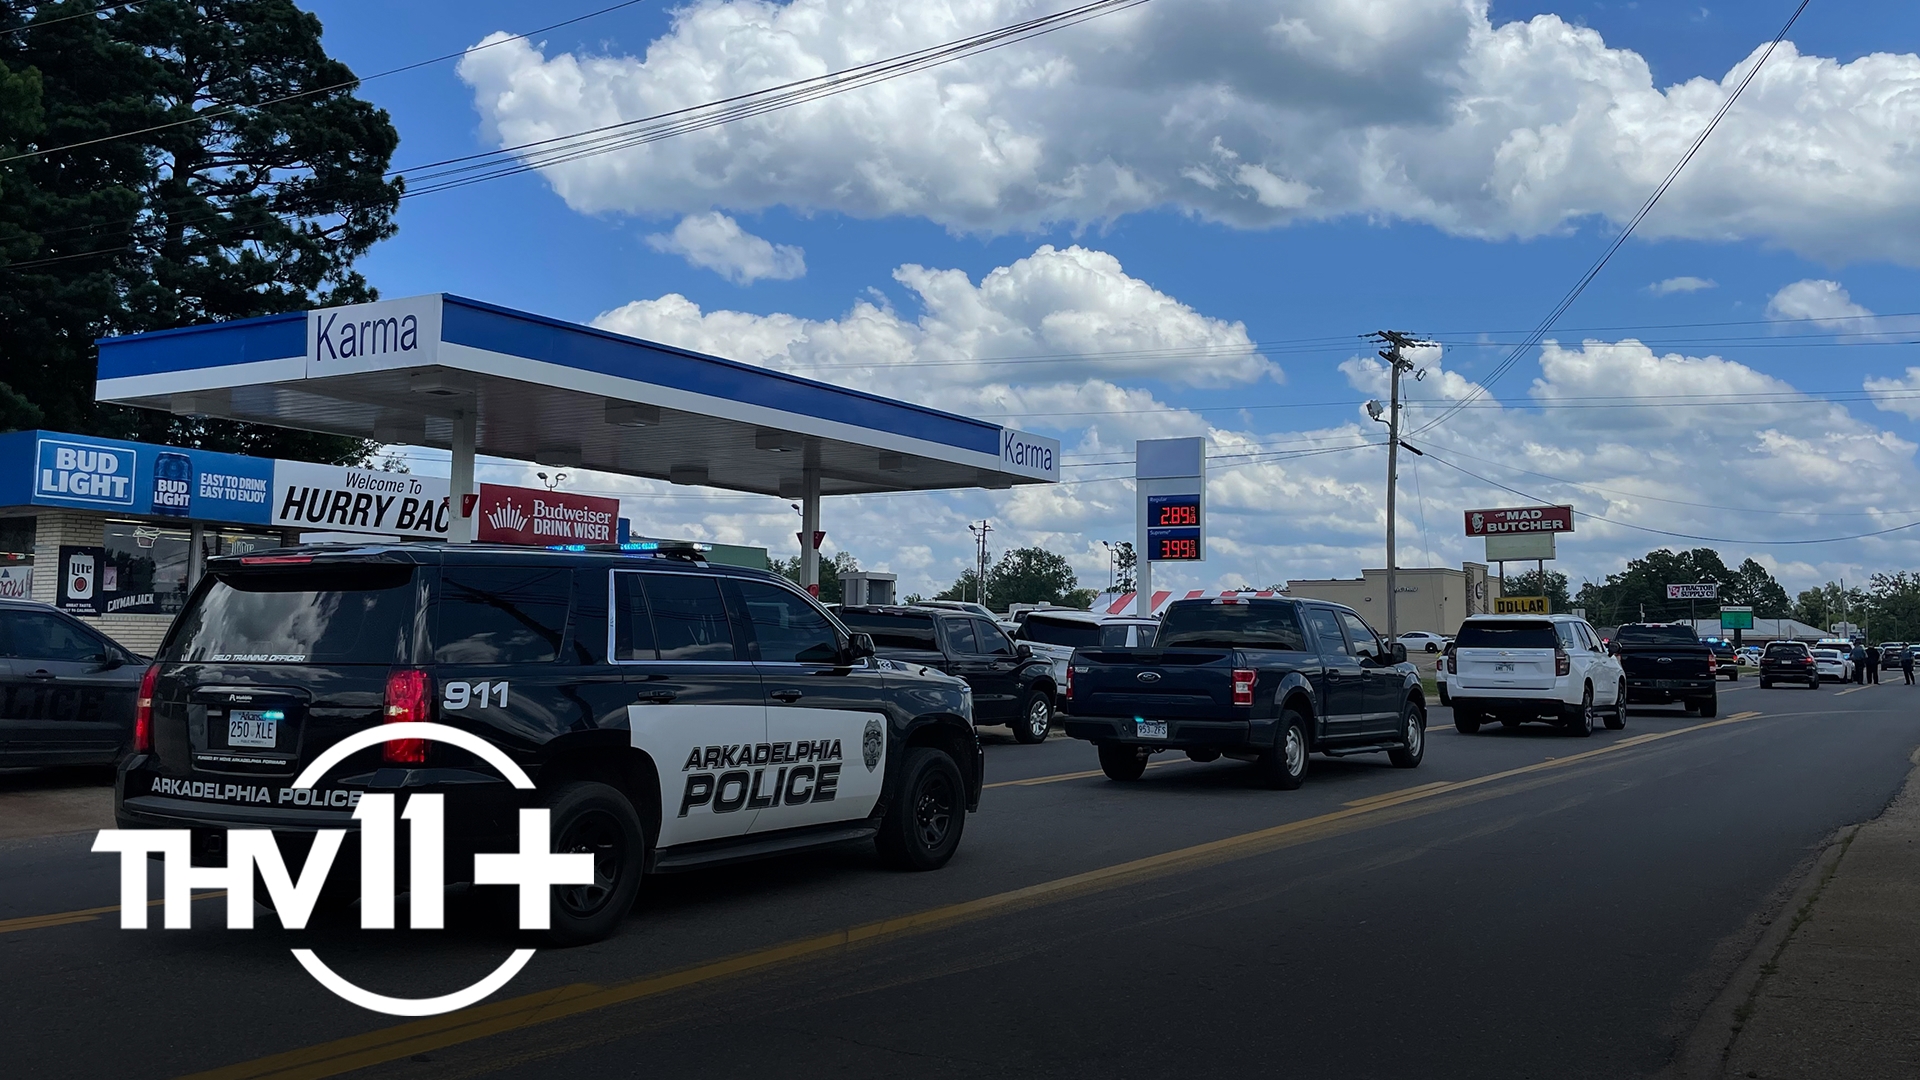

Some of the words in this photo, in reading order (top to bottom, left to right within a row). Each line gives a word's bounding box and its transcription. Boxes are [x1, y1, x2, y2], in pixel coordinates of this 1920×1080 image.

[316, 312, 418, 361] Karma
[56, 447, 118, 475] BUD
[1004, 431, 1053, 471] Karma
[42, 469, 129, 496] LIGHT
[157, 479, 188, 493] BUD
[200, 472, 226, 487] EASY
[226, 475, 238, 488] TO
[239, 477, 267, 491] DRINK
[345, 472, 405, 493] Welcome
[407, 478, 423, 495] To
[153, 491, 190, 507] LIGHT
[200, 485, 224, 499] EASY
[225, 488, 237, 500] TO
[237, 490, 266, 503] ENJOY
[280, 485, 395, 528] HURRY
[395, 495, 450, 533] BAC
[532, 499, 612, 524] Budweiser
[1506, 510, 1542, 520] MAD
[533, 518, 573, 538] DRINK
[573, 522, 610, 541] WISER
[1487, 520, 1563, 532] BUTCHER
[71, 562, 92, 576] Lite
[0, 578, 24, 597] ors
[107, 595, 135, 612] CAYMAN
[135, 594, 154, 605] JACK
[1497, 599, 1545, 613] DOLLAR
[443, 681, 510, 710] 911
[231, 721, 250, 738] 250
[255, 722, 274, 739] XLE
[681, 738, 843, 772] ARKADELPHIA
[151, 776, 271, 804] ARKADELPHIA
[278, 786, 364, 808] POLICE
[677, 762, 843, 818] POLICE
